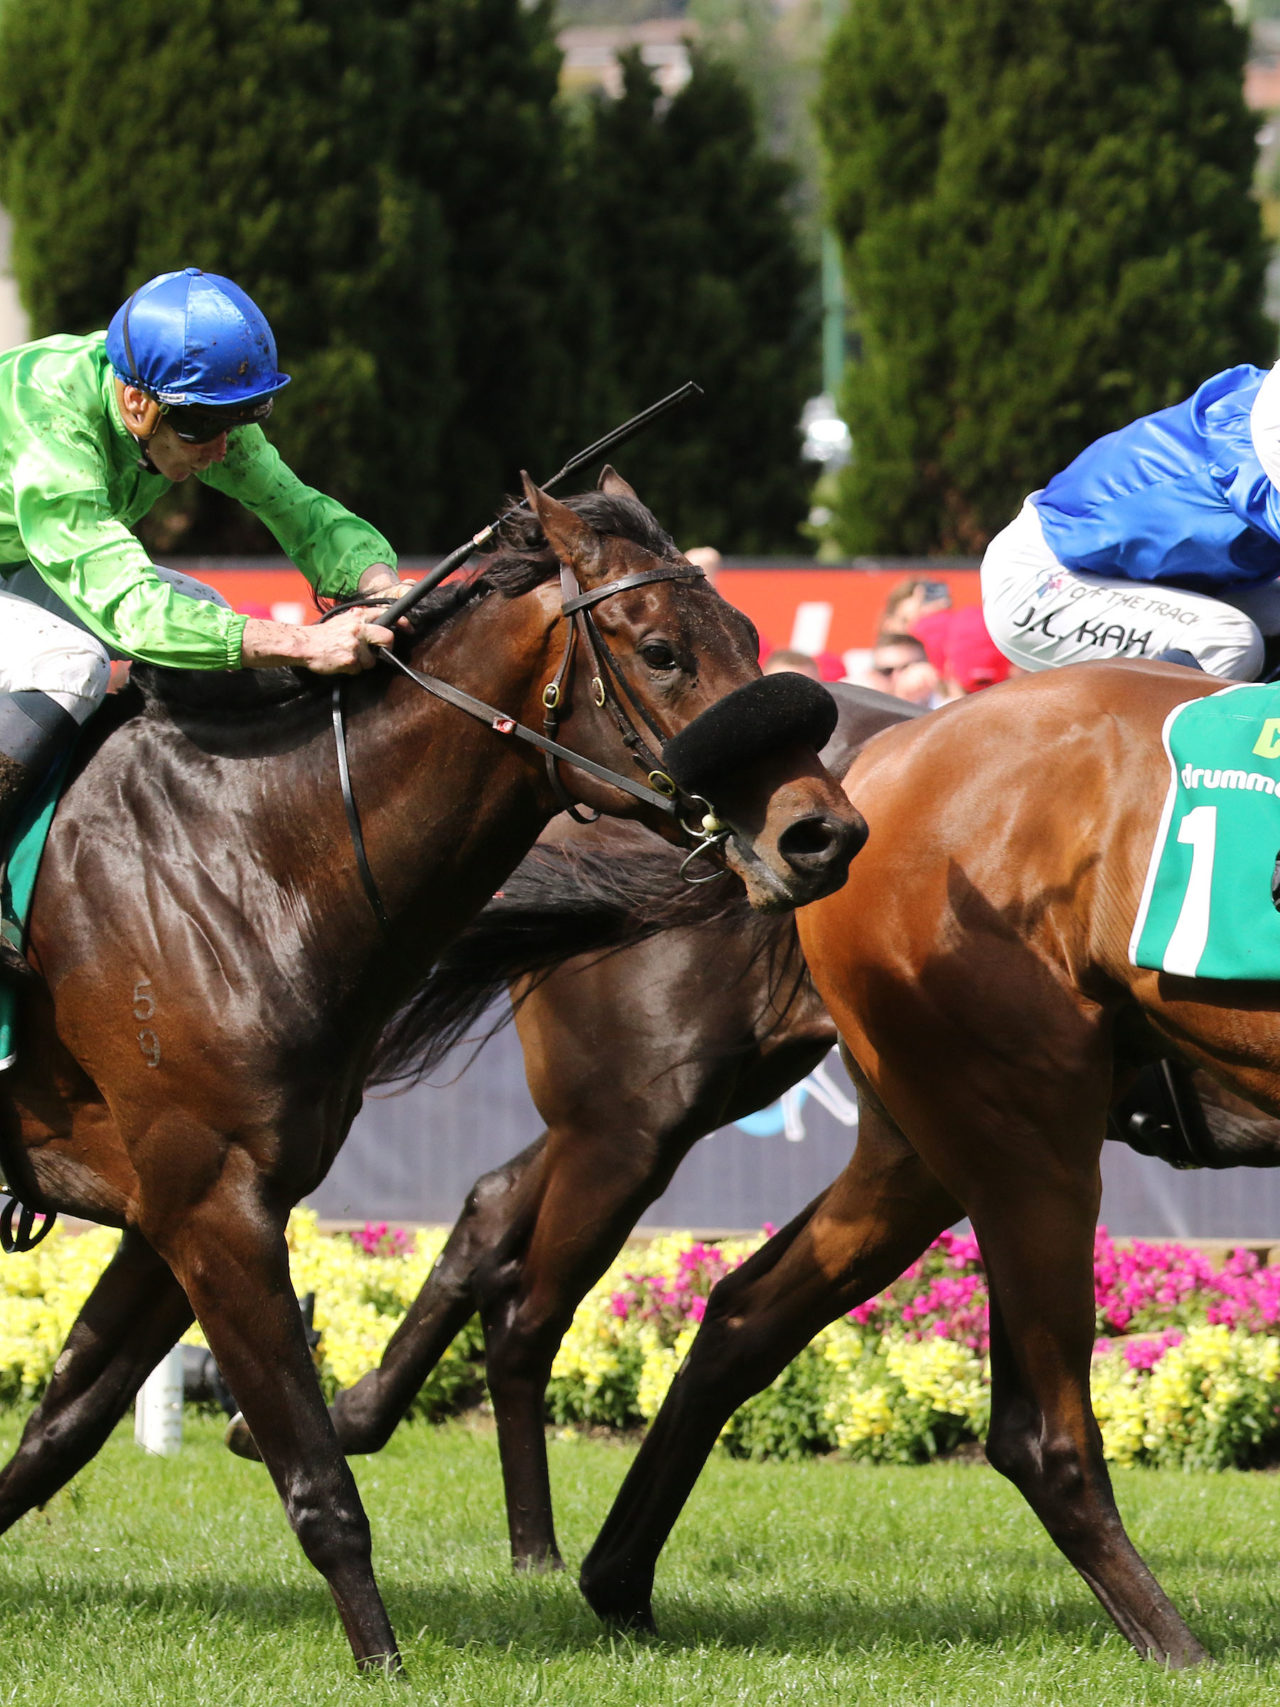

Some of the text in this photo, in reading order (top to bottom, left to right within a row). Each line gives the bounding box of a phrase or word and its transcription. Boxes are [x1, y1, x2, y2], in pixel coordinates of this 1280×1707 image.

[1106, 591, 1143, 609] THE
[1076, 620, 1153, 655] KAH
[1163, 805, 1217, 979] 1
